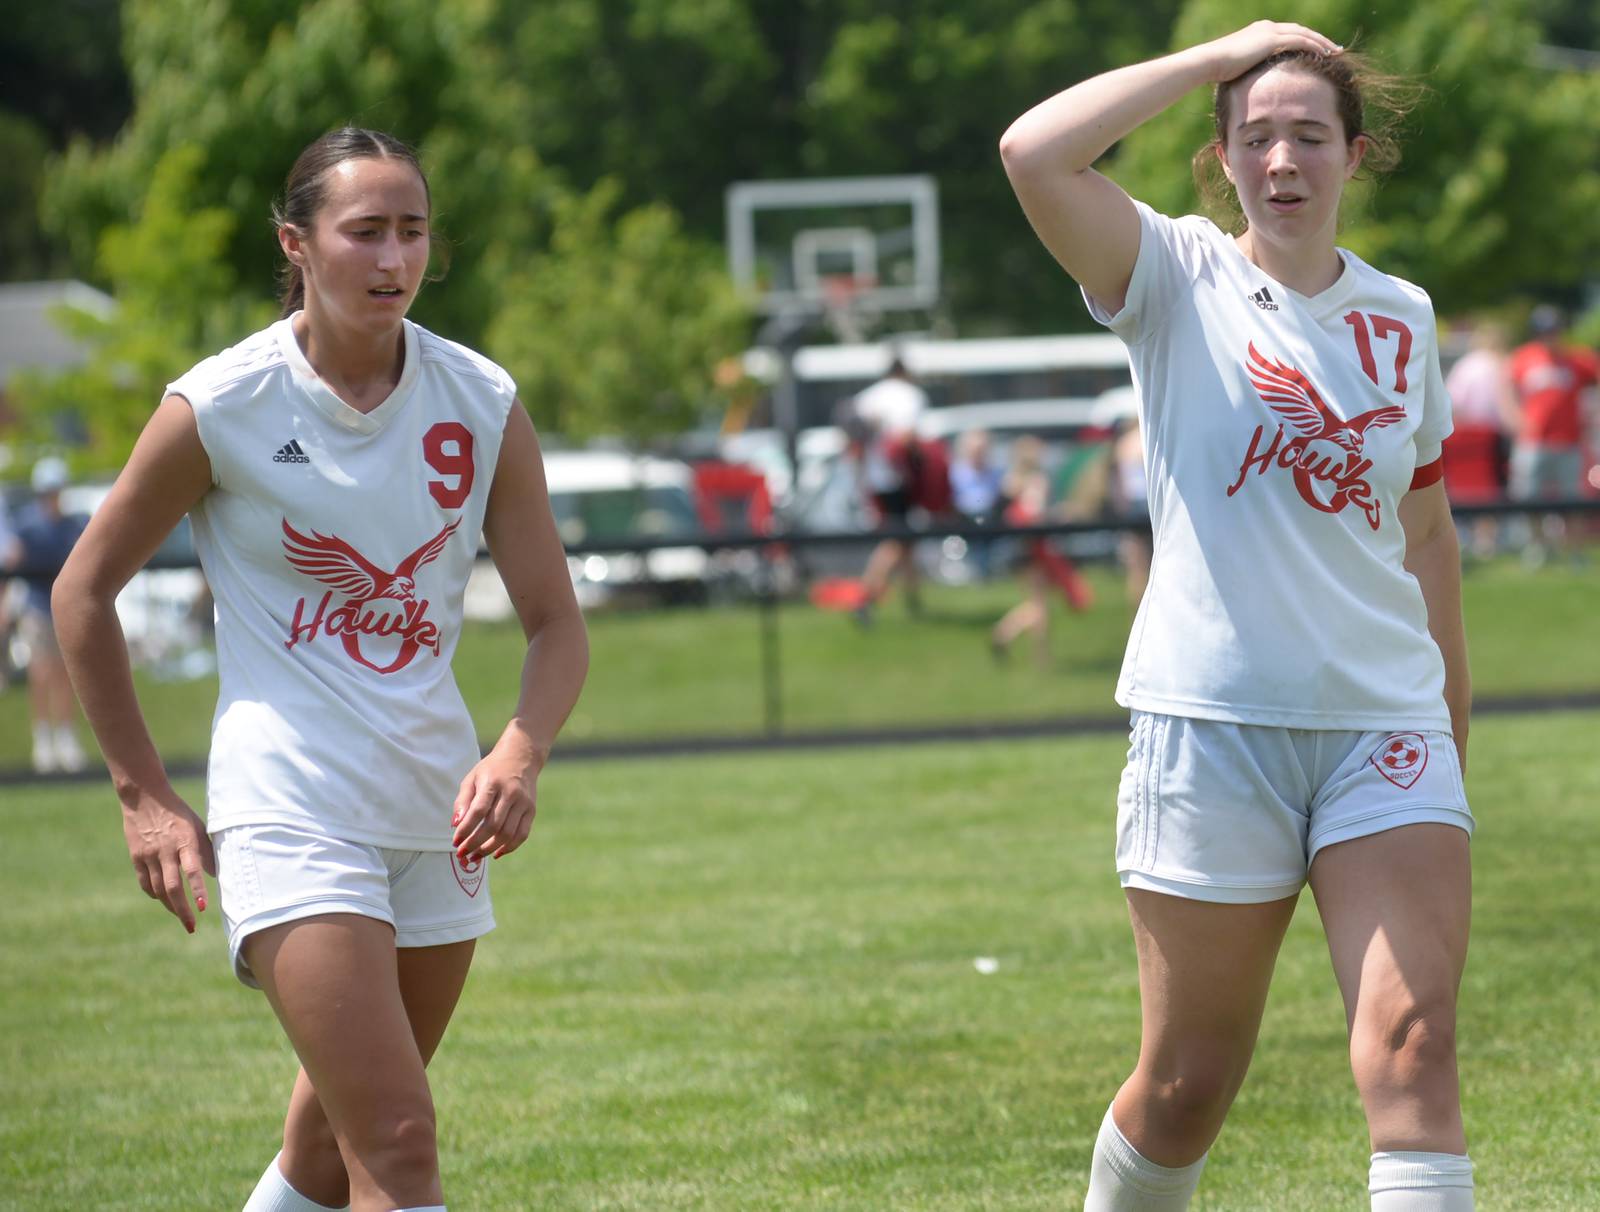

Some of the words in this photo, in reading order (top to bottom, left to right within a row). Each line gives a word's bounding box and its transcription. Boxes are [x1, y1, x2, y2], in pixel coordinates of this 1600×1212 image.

[1343, 310, 1413, 394] 17
[272, 453, 311, 464] adidas
[422, 421, 475, 510] 9
